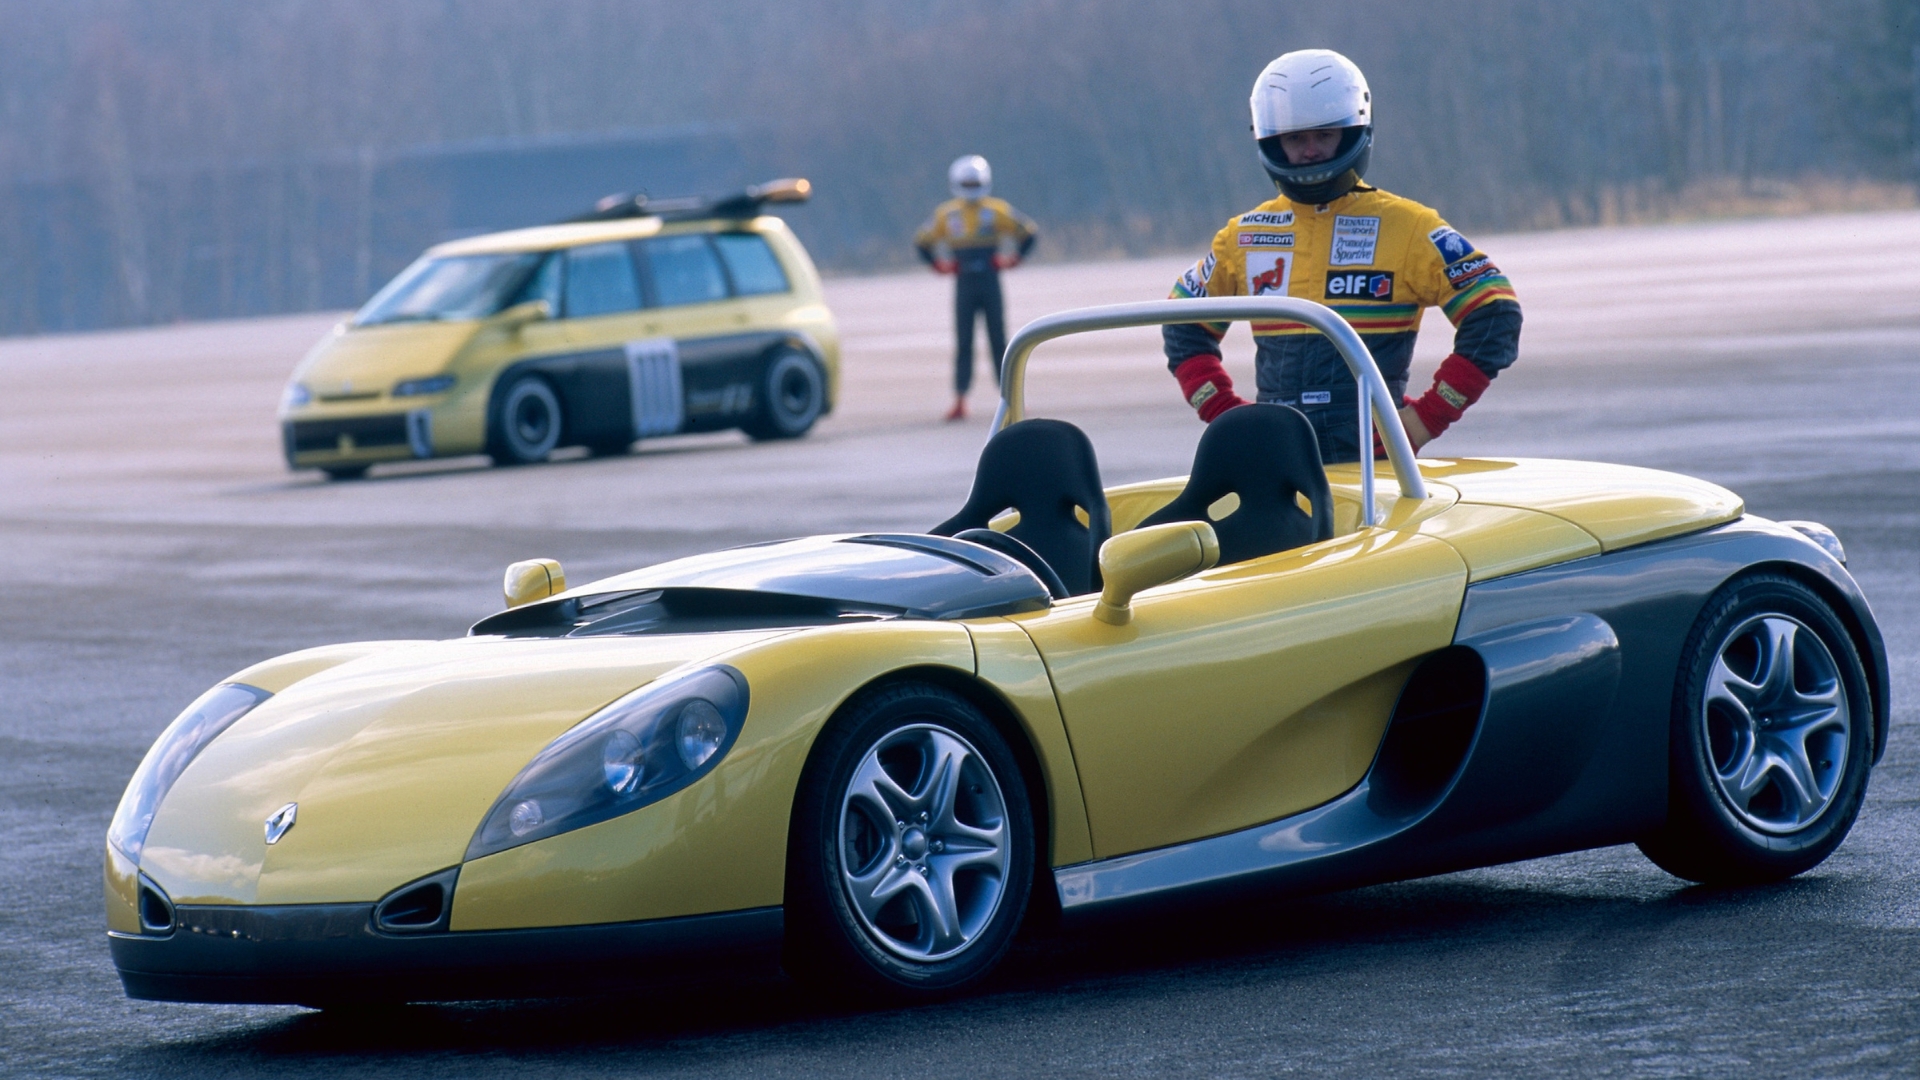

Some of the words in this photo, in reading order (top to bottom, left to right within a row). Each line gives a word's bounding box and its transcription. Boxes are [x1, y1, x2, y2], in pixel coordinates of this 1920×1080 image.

[1241, 213, 1293, 224] MICHELIN
[1337, 218, 1377, 226] RENAULT
[1351, 227, 1373, 235] sport
[1336, 237, 1374, 248] Promotion
[1334, 247, 1373, 263] Sportive
[1449, 266, 1463, 278] de
[1328, 275, 1367, 294] elf
